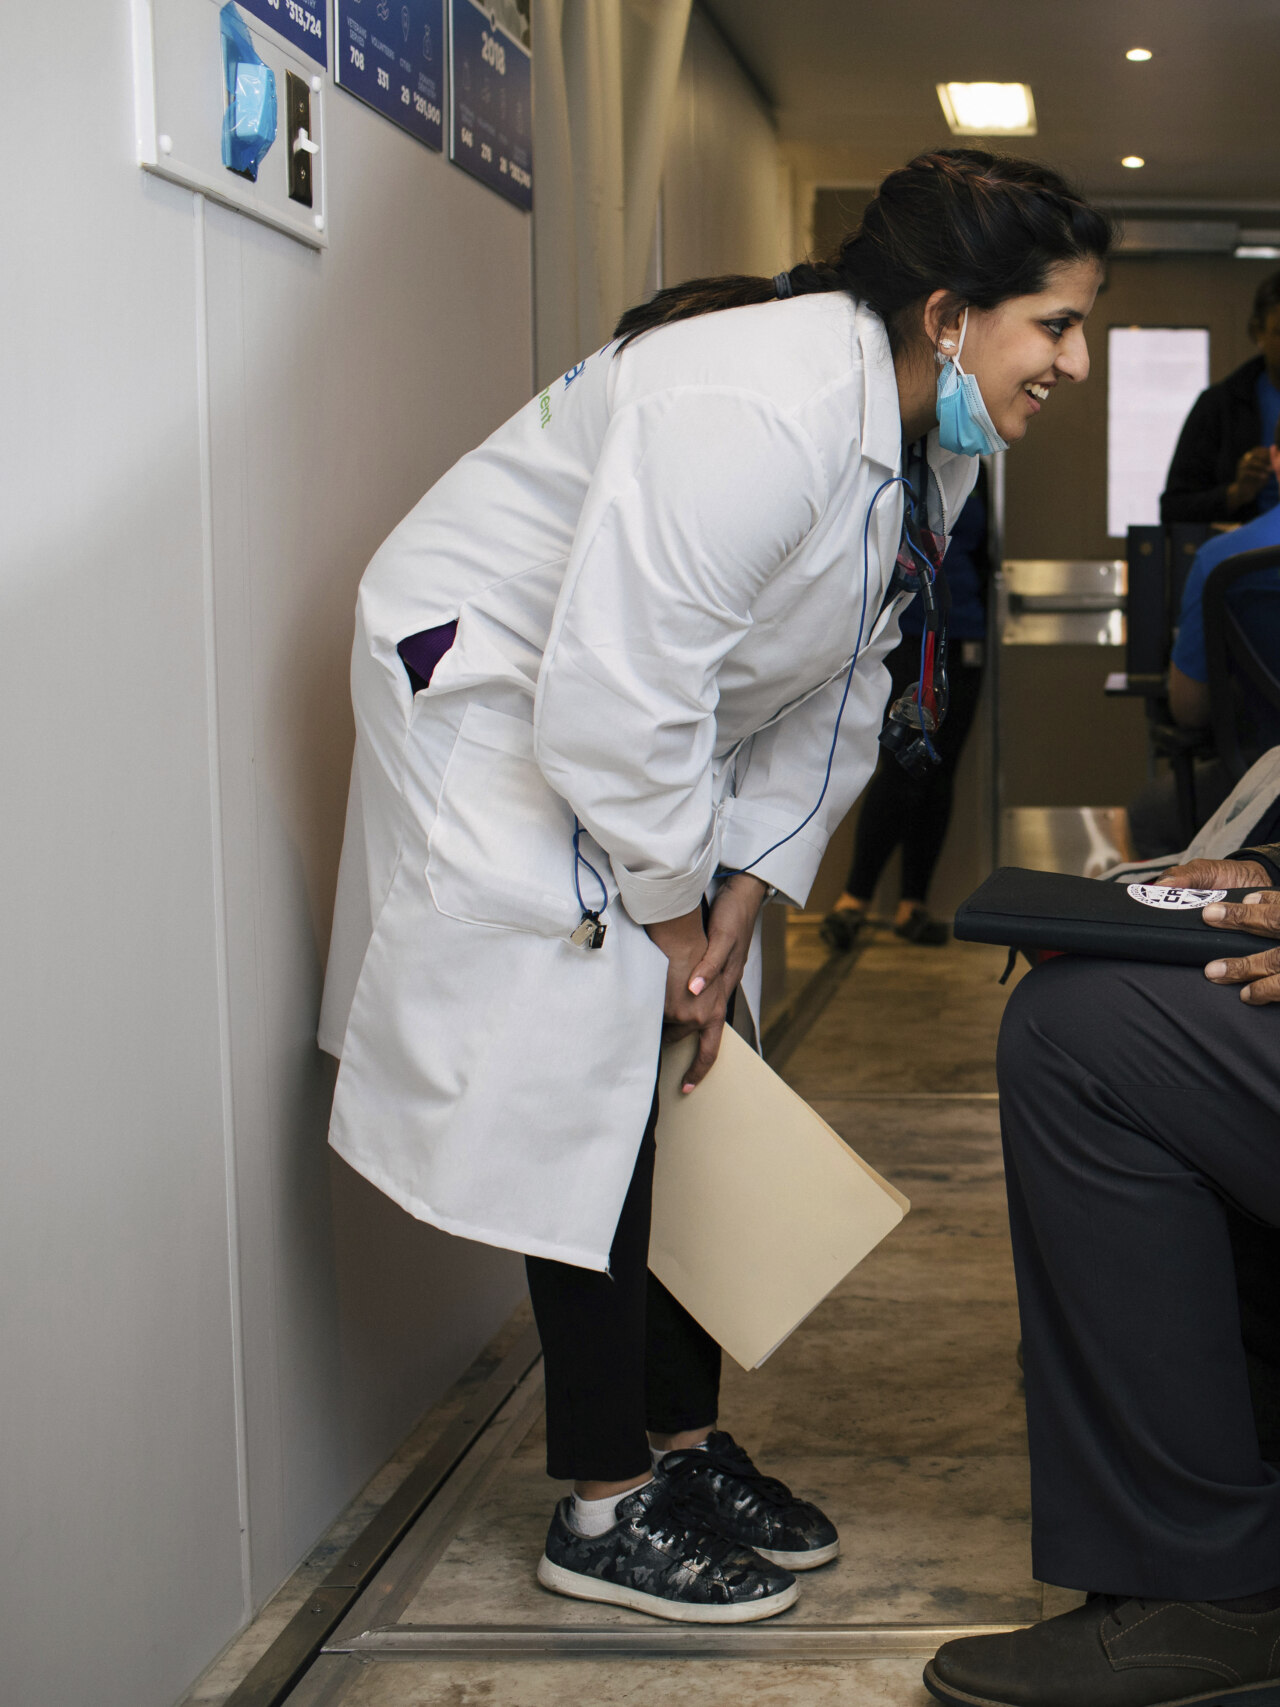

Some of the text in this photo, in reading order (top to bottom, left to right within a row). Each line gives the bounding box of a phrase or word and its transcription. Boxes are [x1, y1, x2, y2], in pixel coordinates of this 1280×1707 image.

[285, 0, 322, 38] $313,724
[349, 45, 365, 71] 708
[481, 31, 506, 76] 2018
[377, 67, 389, 91] 331
